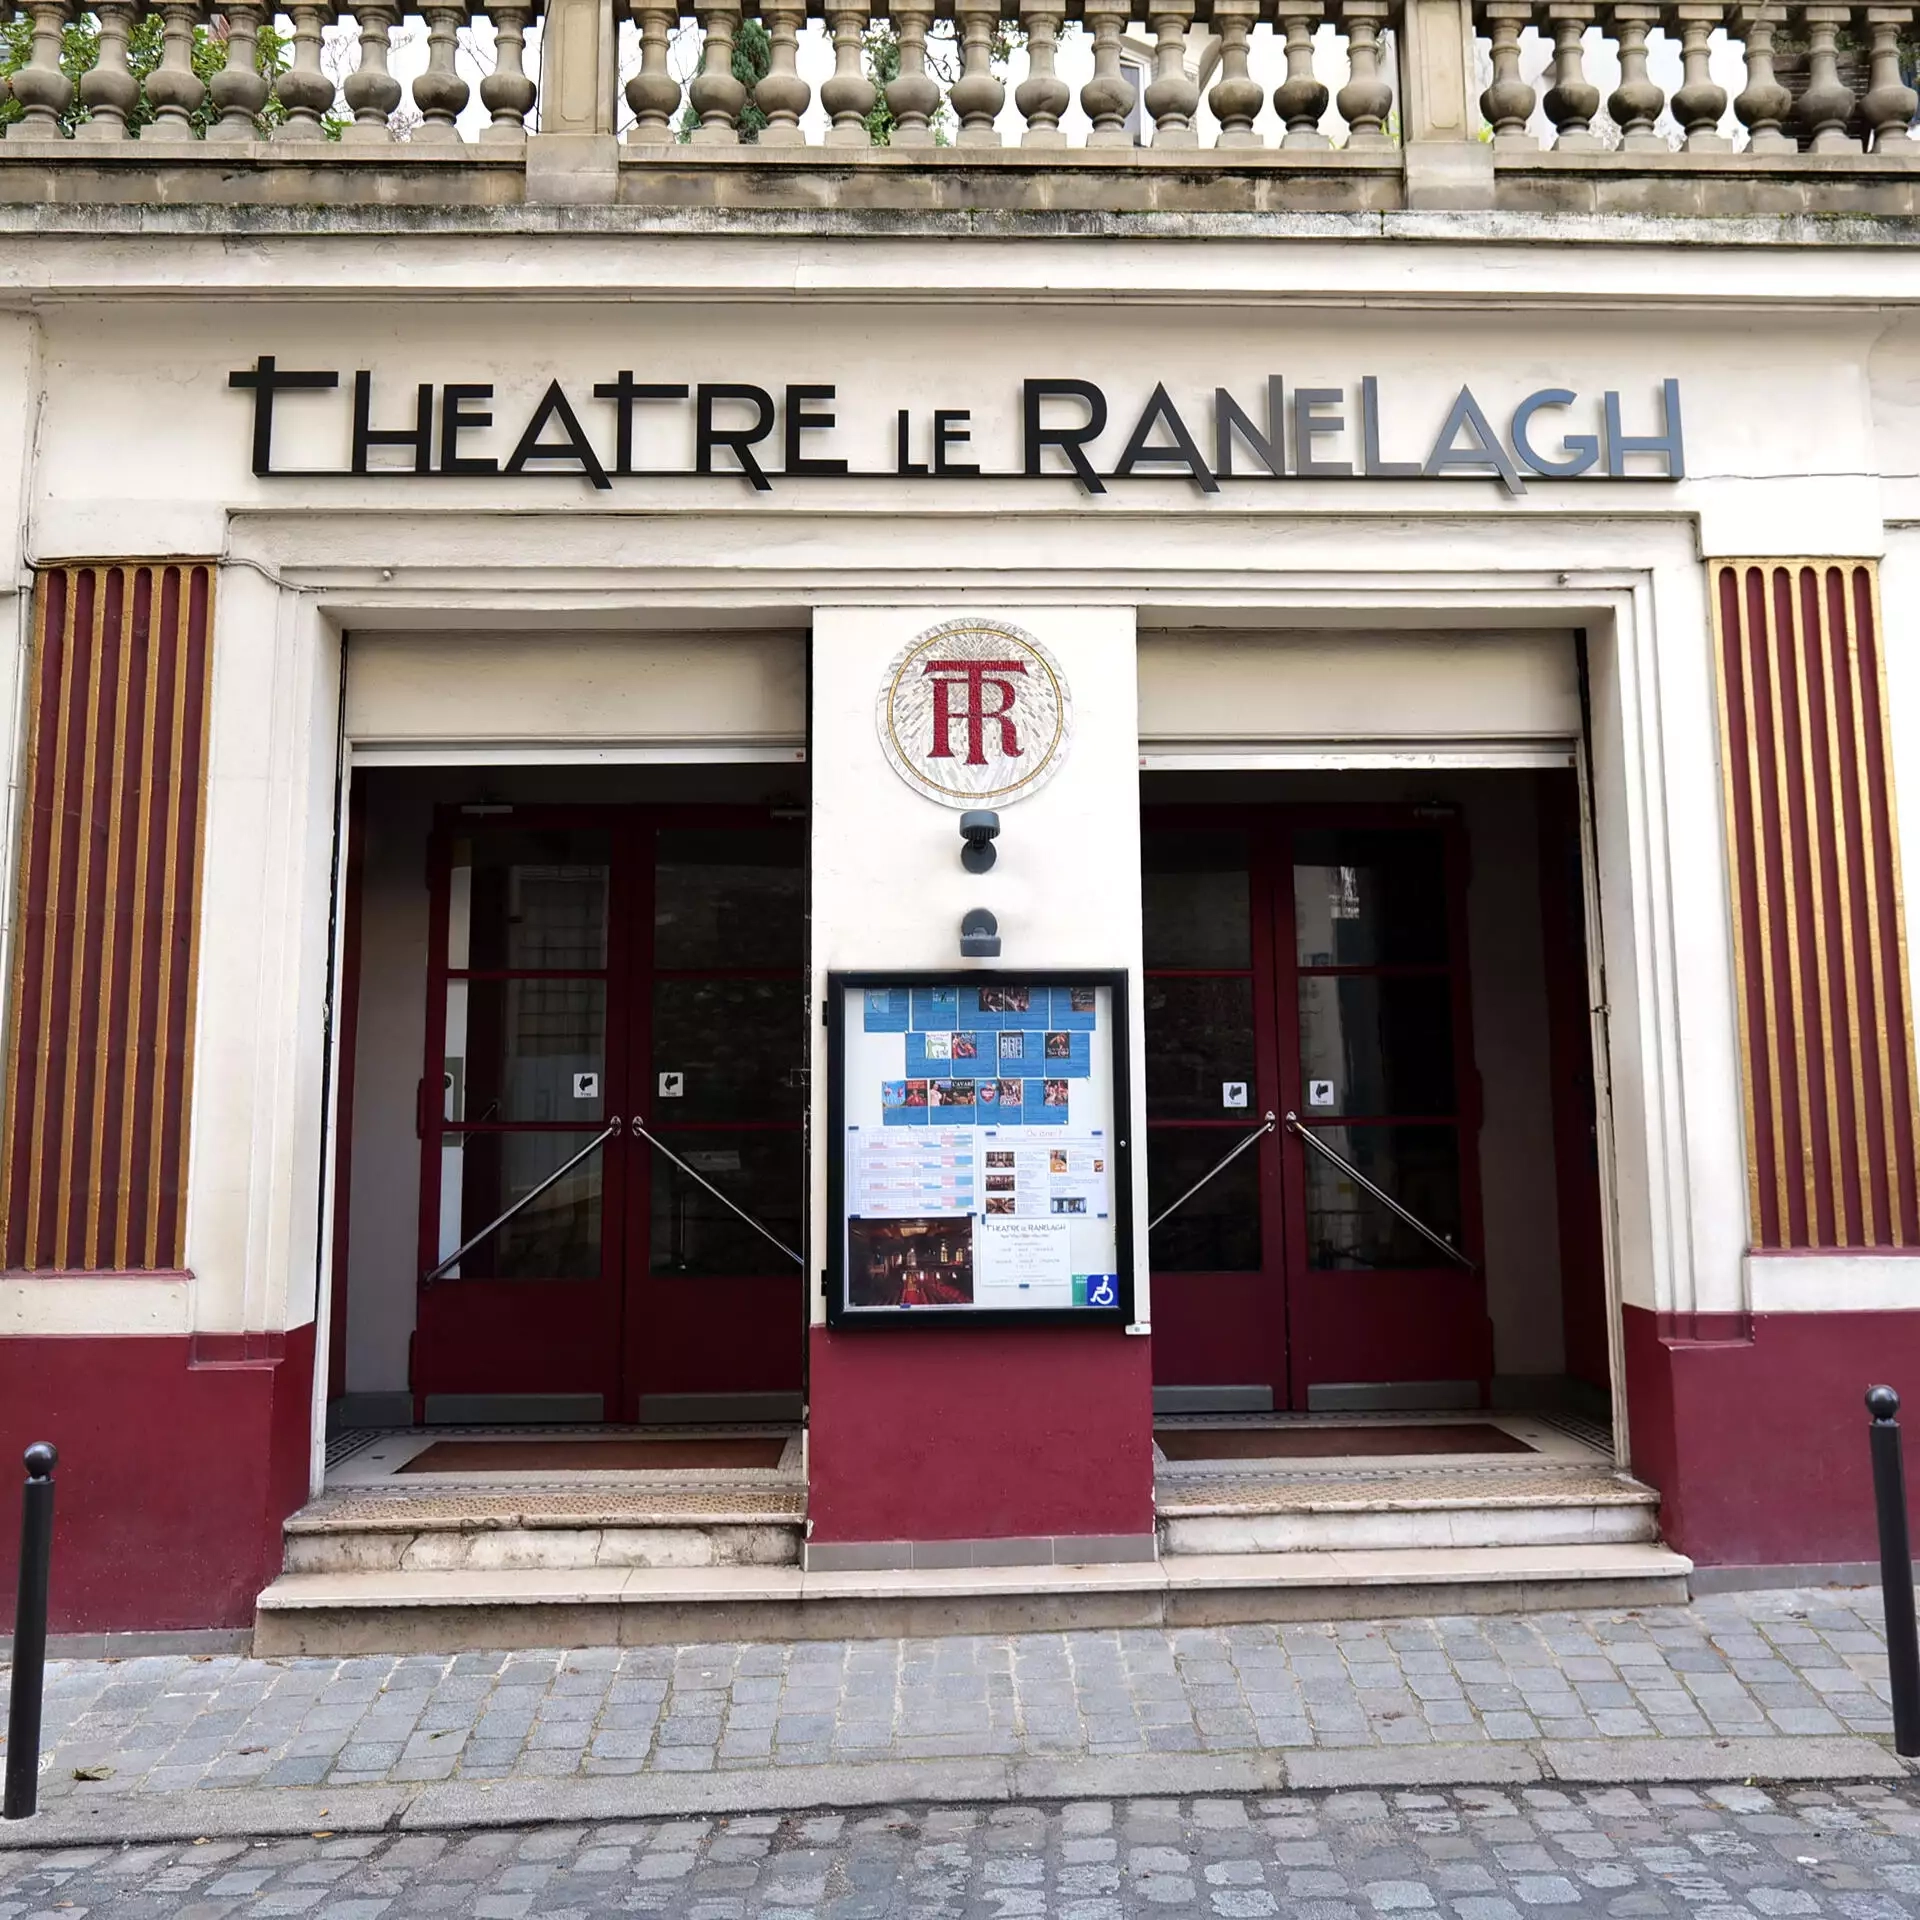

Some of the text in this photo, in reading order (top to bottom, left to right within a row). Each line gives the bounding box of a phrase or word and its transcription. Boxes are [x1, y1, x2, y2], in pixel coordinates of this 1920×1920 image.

[229, 356, 1685, 494] THEATRE LE RANELAGH
[1028, 1223, 1066, 1231] RANELAGH
